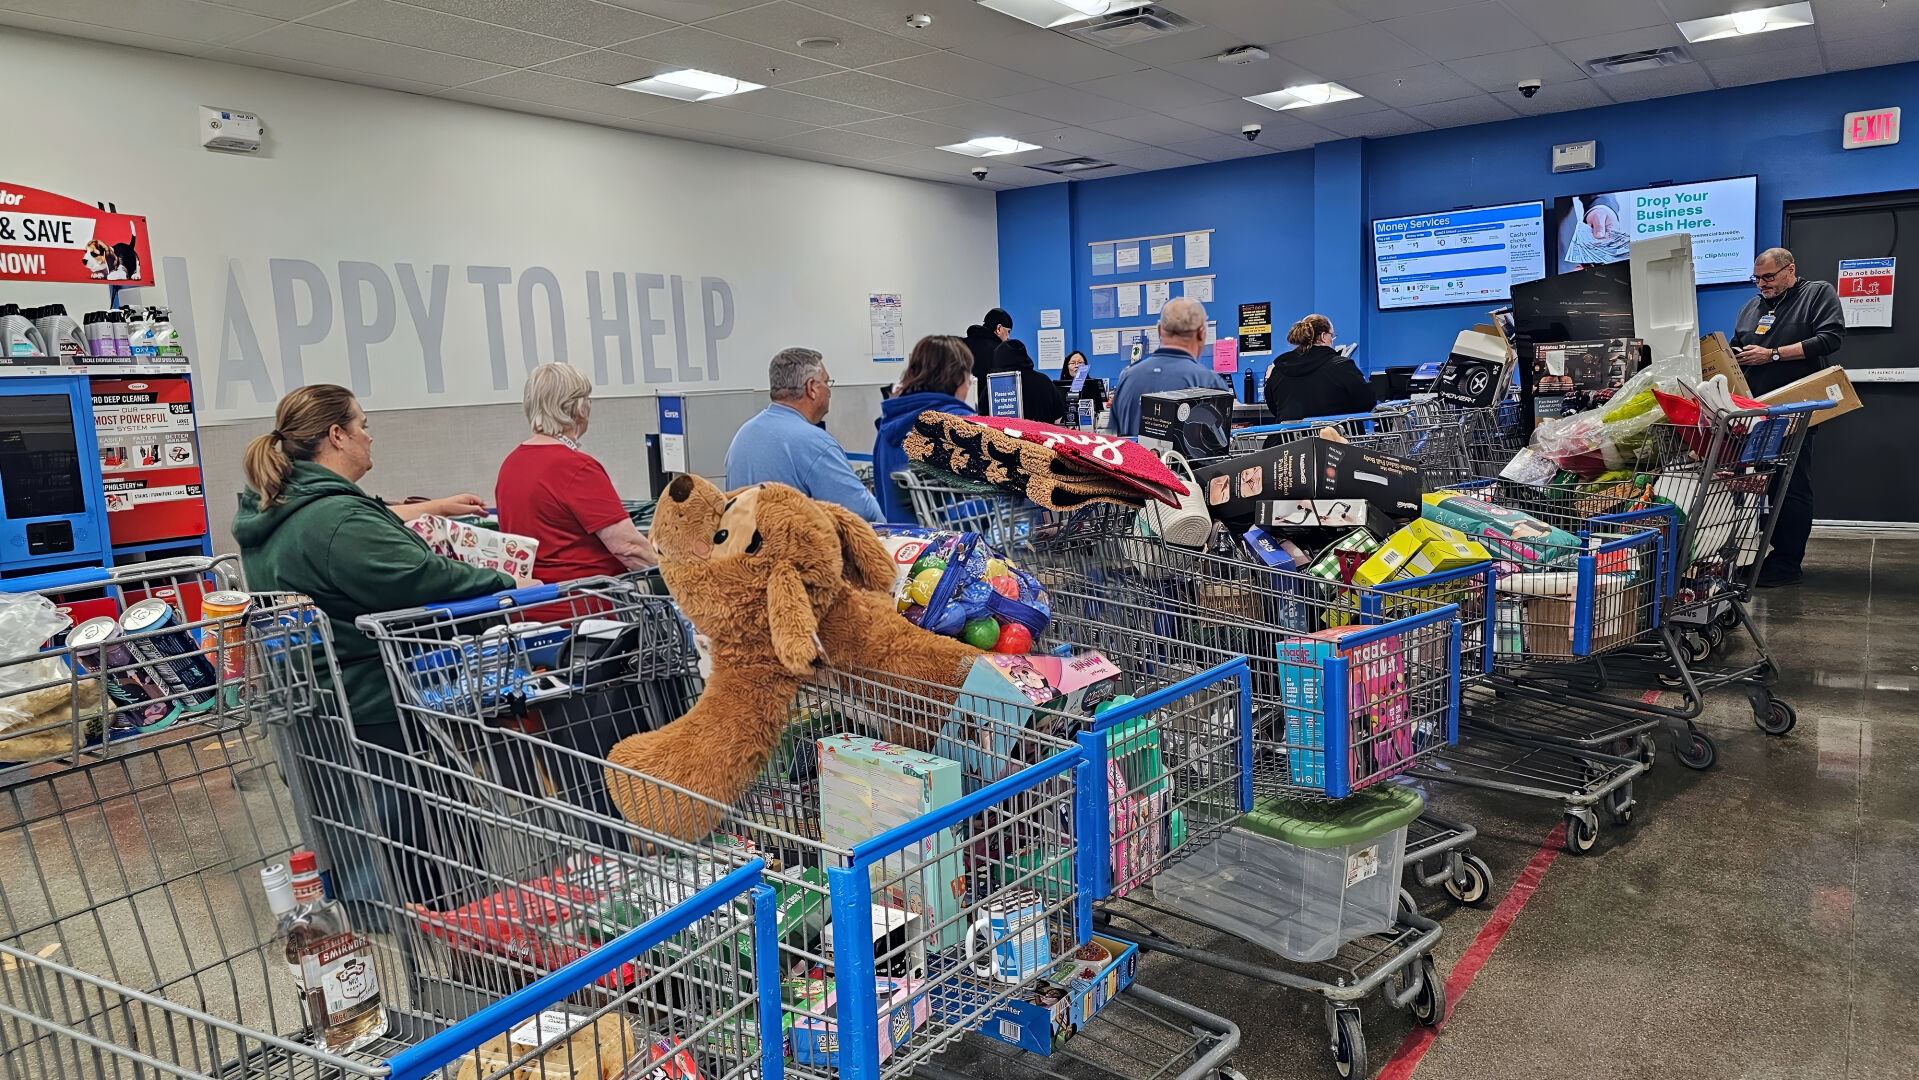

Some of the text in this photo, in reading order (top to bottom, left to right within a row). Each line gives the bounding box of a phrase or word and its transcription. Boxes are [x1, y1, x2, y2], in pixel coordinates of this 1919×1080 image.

[1852, 113, 1894, 143] EXIT
[0, 190, 24, 206] tor
[1637, 192, 1709, 208] Drop Your
[1637, 206, 1703, 220] Business
[0, 216, 75, 244] & SAVE
[1377, 217, 1450, 232] Money Services
[1637, 219, 1716, 233] Cash Here.
[466, 264, 569, 392] TO
[586, 269, 736, 387] HELP
[92, 394, 150, 404] RO DEEP CLEANER
[95, 412, 169, 426] MOST POWERFUL
[323, 936, 368, 962] SMIRNOFF
